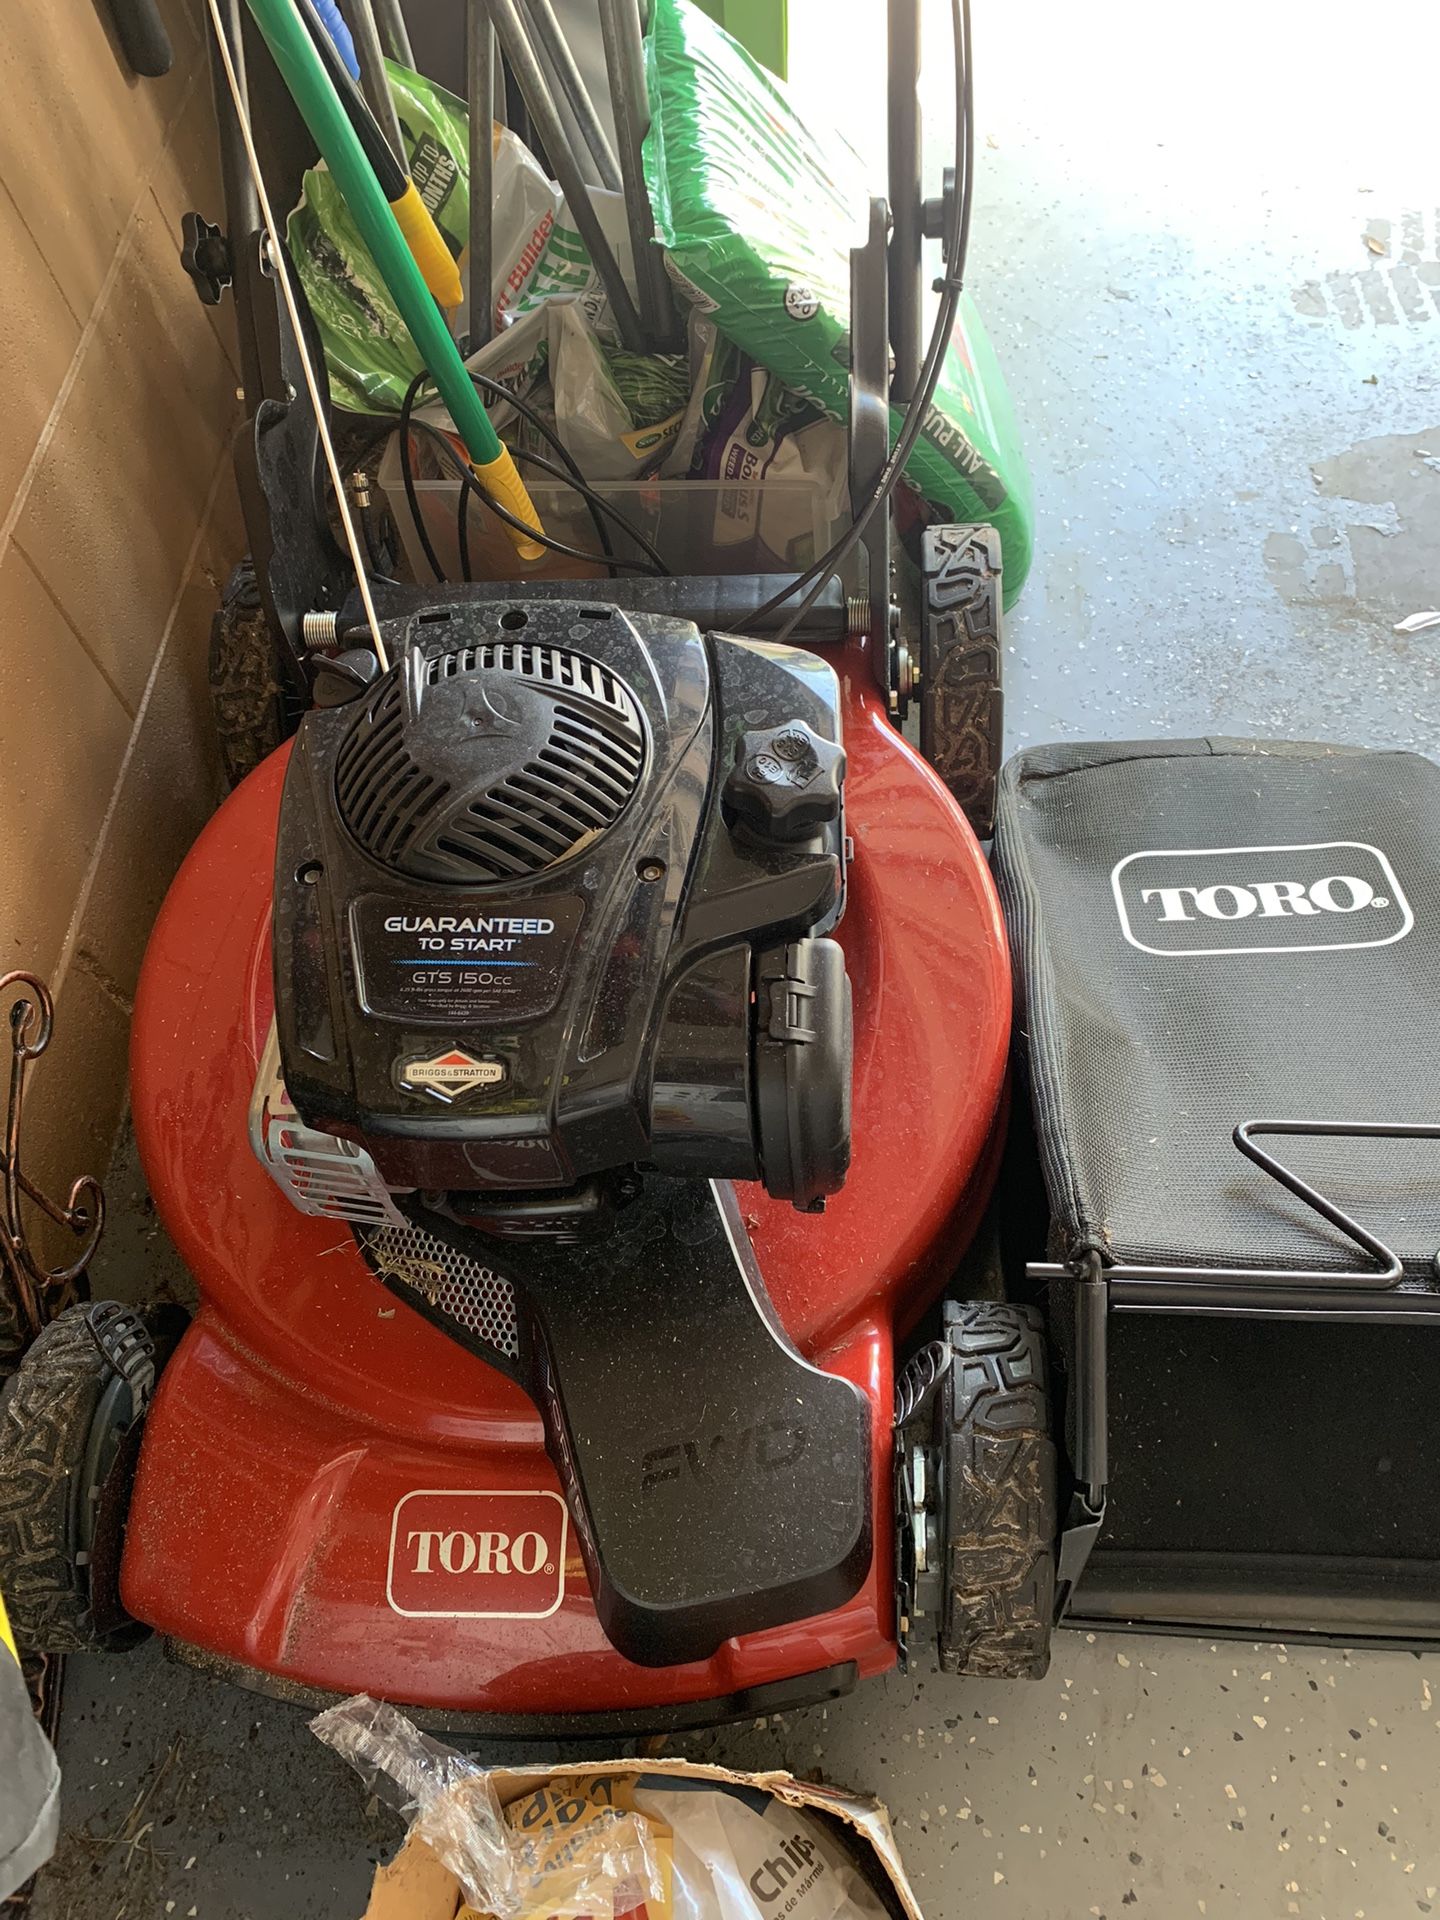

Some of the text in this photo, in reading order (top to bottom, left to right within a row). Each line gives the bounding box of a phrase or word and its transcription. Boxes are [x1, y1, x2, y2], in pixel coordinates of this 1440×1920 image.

[411, 143, 440, 184] UP TO
[507, 208, 555, 293] Builder
[725, 446, 742, 476] WEED
[384, 916, 555, 935] GUARANTEED
[418, 937, 516, 952] TO START
[412, 971, 513, 986] GTS 150cc
[784, 1897, 799, 1913] de
